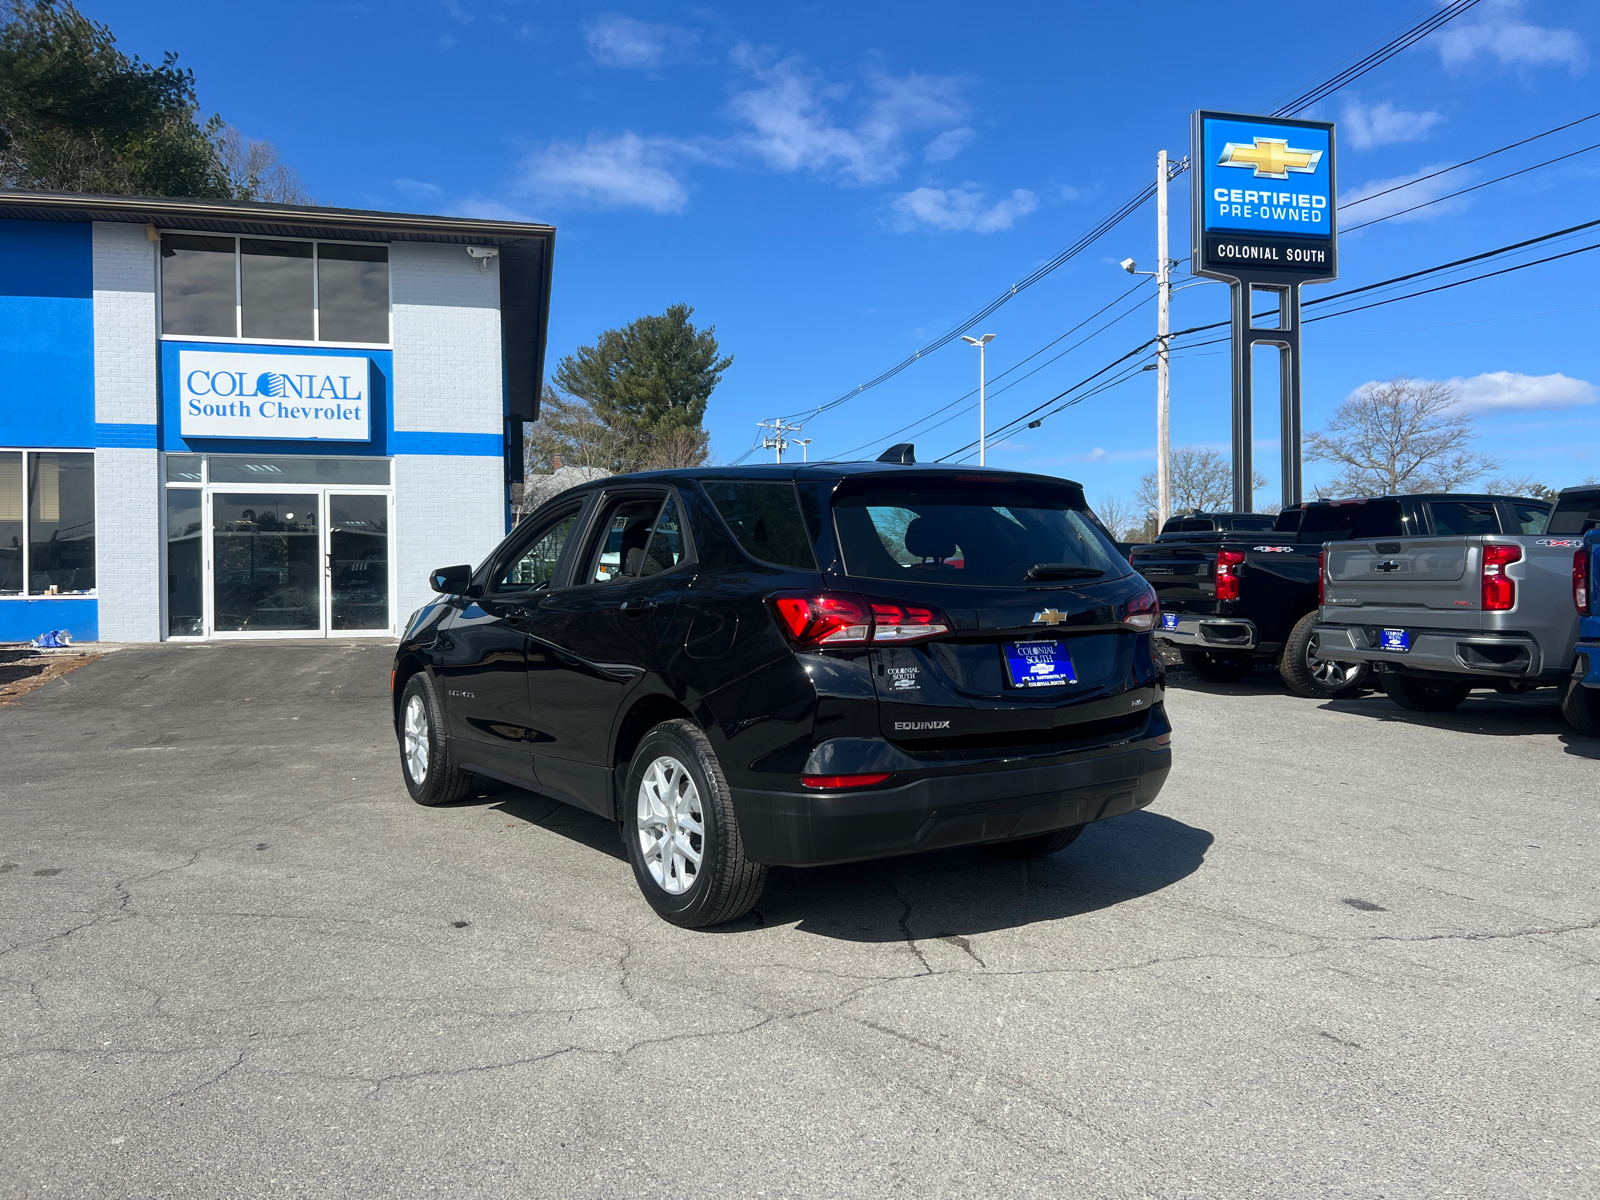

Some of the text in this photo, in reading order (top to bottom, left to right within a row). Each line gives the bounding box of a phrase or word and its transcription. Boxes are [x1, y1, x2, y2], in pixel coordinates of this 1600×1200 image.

[1214, 188, 1327, 209] CERTIFIED
[1220, 204, 1322, 223] PRE-OWNED
[1217, 244, 1325, 263] COLONIAL SOUTH
[187, 370, 362, 400] COLONIAL
[188, 399, 362, 421] South Chevrolet
[1017, 646, 1057, 656] COLONIAL
[1025, 655, 1054, 664] SOUTH
[887, 667, 920, 675] COLONIAL
[894, 720, 950, 730] EQUINOX
